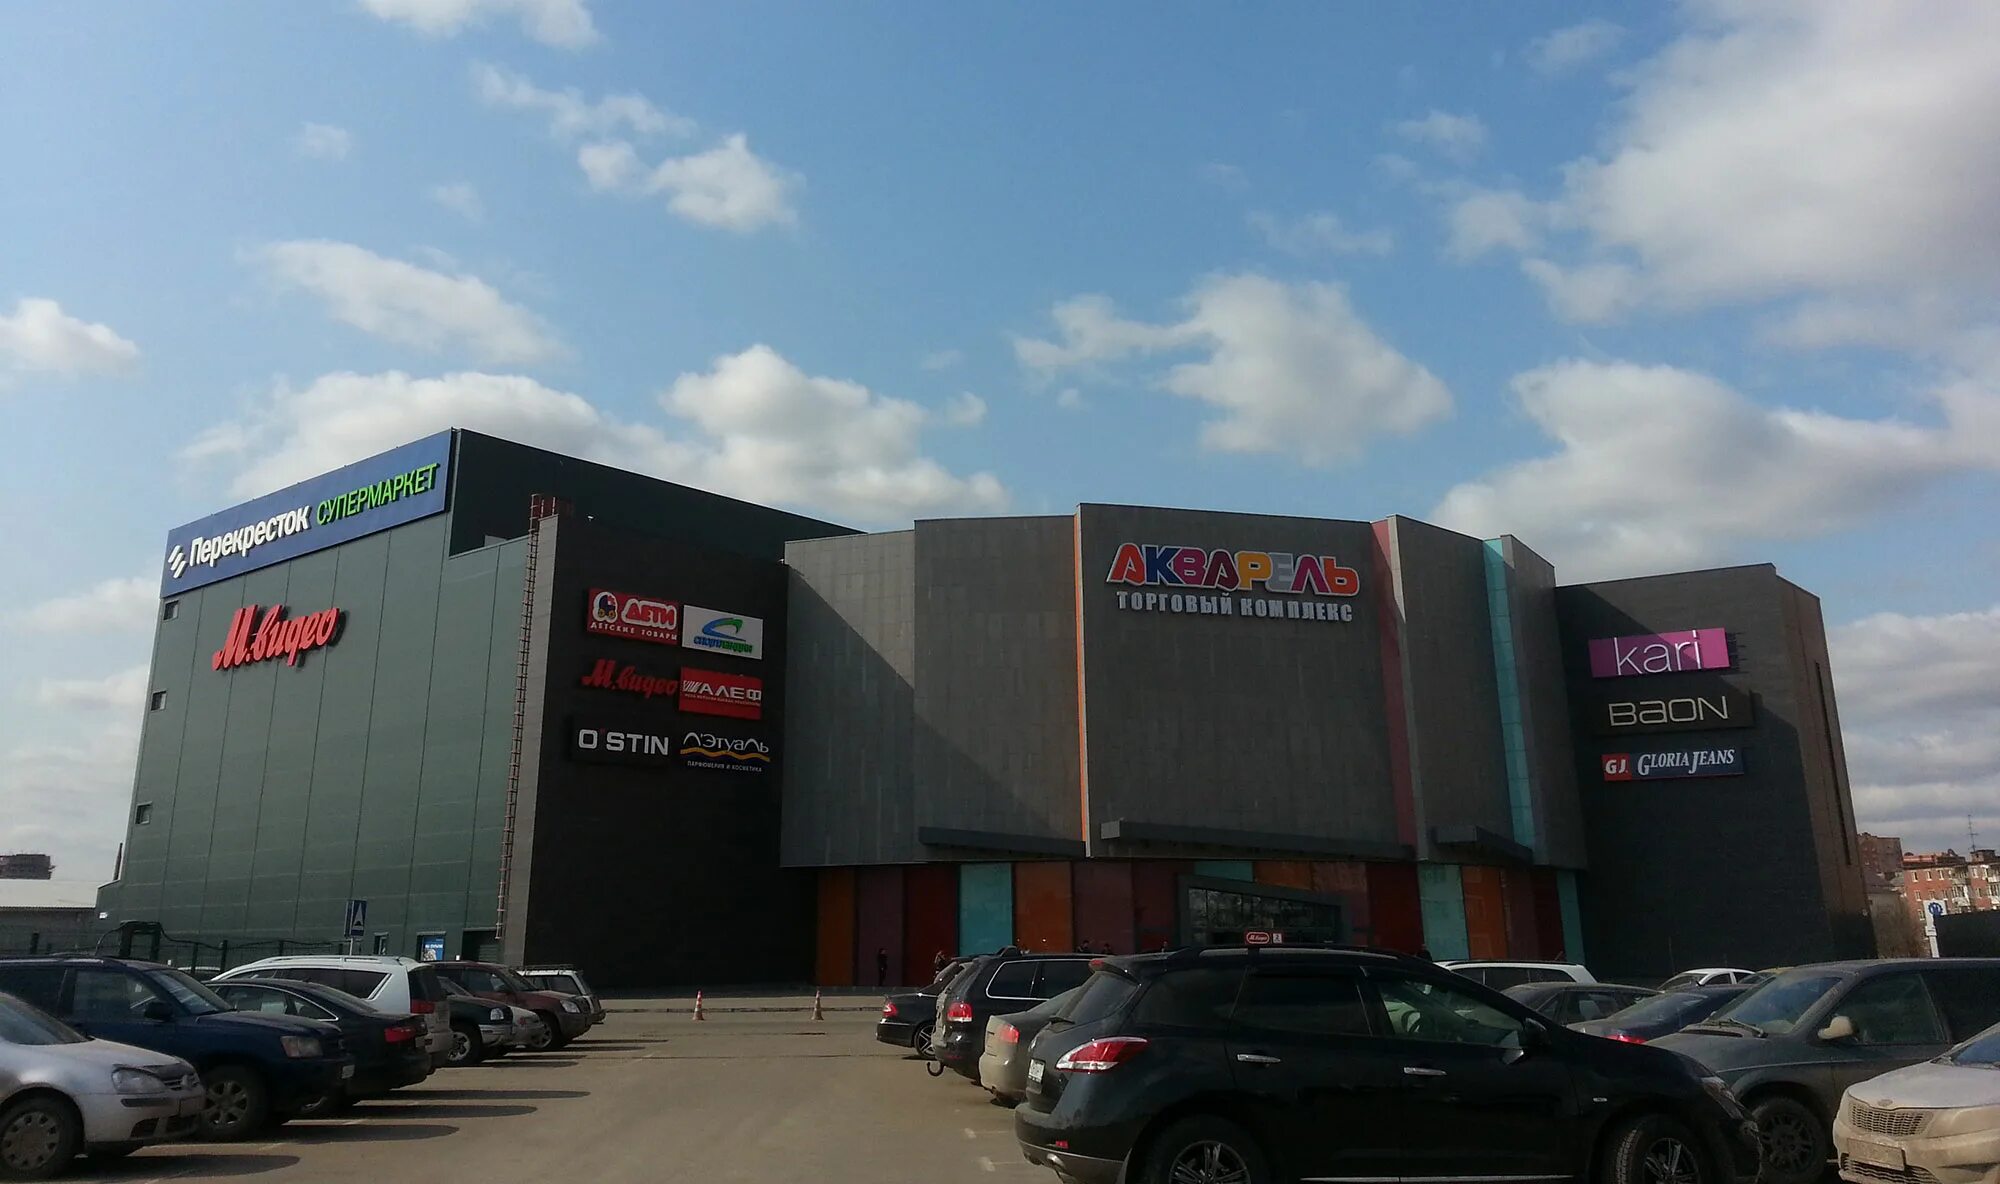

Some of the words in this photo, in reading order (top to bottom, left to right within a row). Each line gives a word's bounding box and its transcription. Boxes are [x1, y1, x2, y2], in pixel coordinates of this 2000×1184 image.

[189, 504, 311, 567] Перекресток
[316, 463, 440, 526] СУПЕРМАРКЕТ
[1106, 543, 1359, 596] АКВАРЕЛЬ
[622, 599, 677, 629] ДЕТИ
[1116, 591, 1233, 615] ТОРГОВЫЙ
[1240, 599, 1353, 622] КОМПЛЕКС
[590, 621, 635, 635] ДЕТСКИЕ
[641, 629, 678, 641] ТОВАРЫ
[1613, 629, 1701, 676] kari
[698, 682, 762, 701] АЛЕФ
[1637, 752, 1690, 776] GLORIA
[1689, 749, 1735, 775] JEANS
